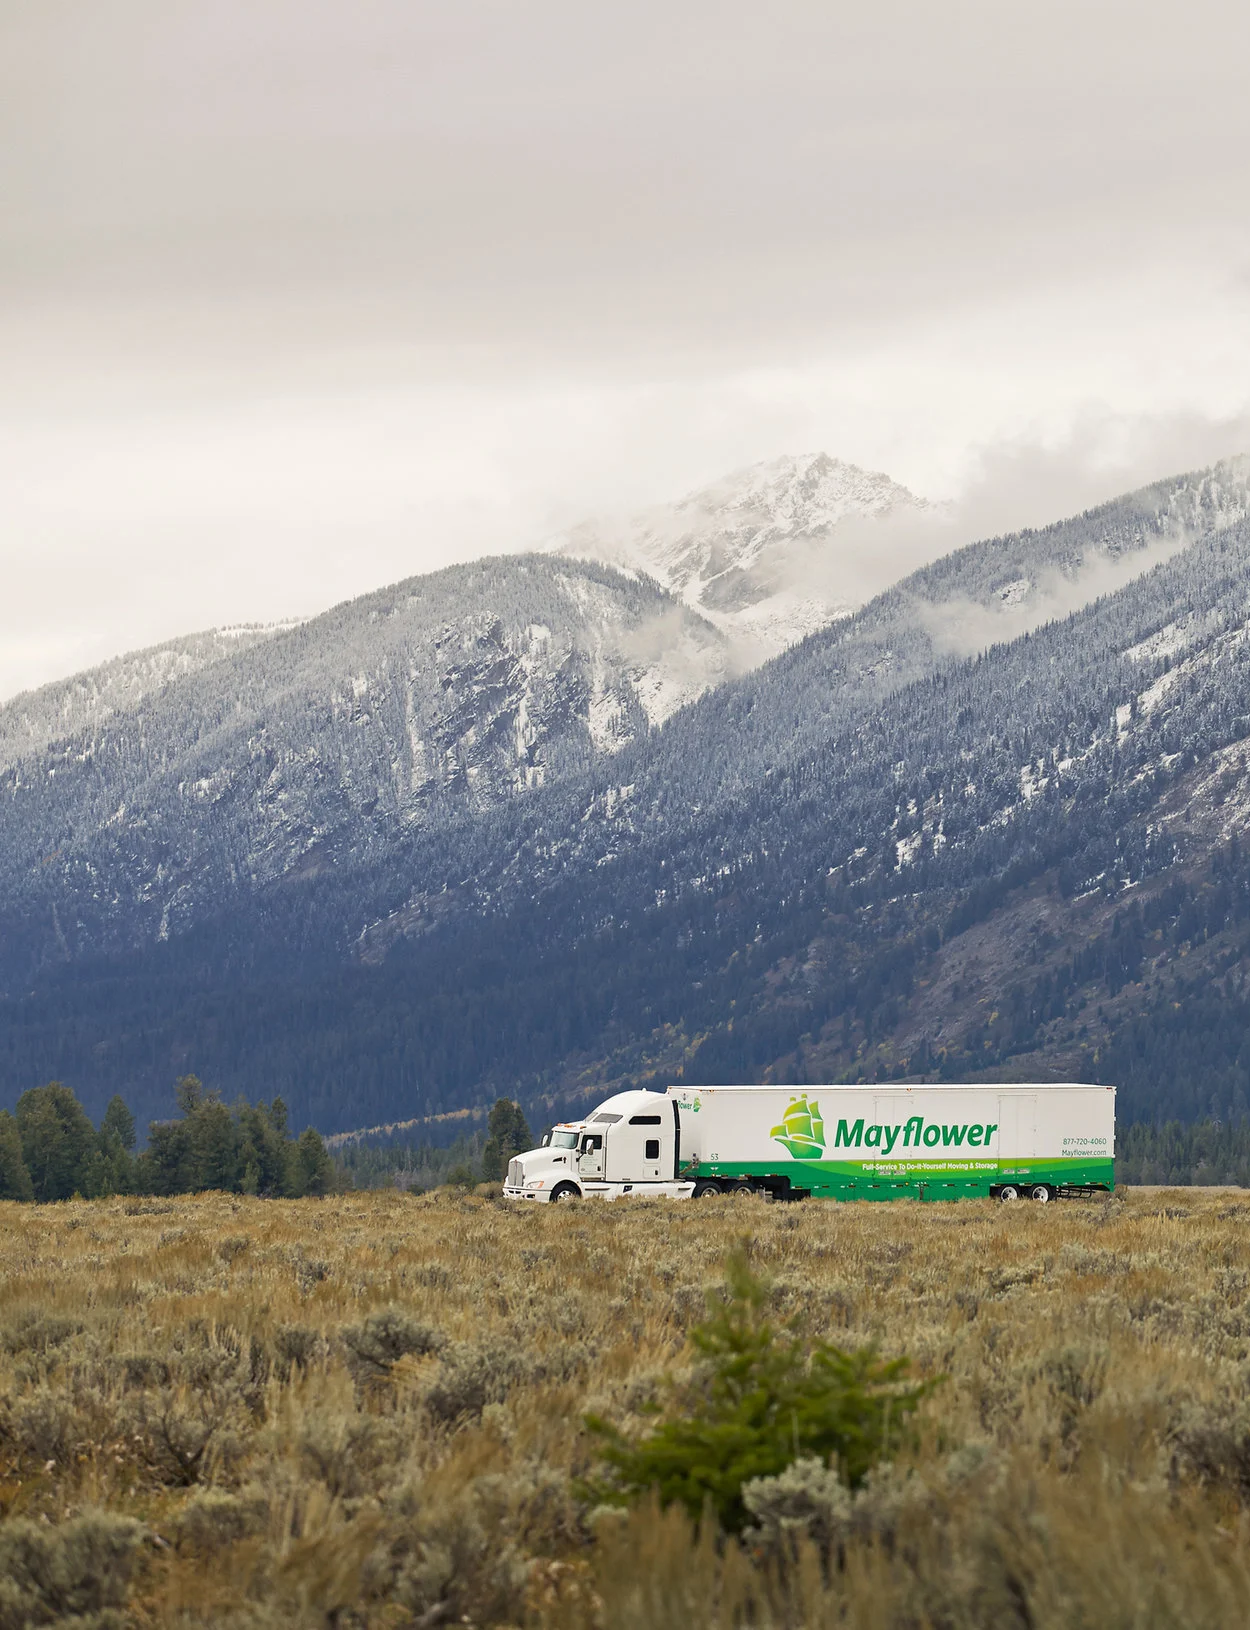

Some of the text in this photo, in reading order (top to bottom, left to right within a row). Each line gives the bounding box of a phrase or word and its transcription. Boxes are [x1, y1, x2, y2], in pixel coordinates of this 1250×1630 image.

[835, 1116, 998, 1155] Mayflower
[710, 1153, 719, 1161] 53
[1061, 1149, 1107, 1157] Mayflower.com
[862, 1163, 897, 1171] Full-Service
[906, 1162, 946, 1170] Do-It-Yourself
[947, 1162, 968, 1170] Moving
[975, 1162, 998, 1170] Storage
